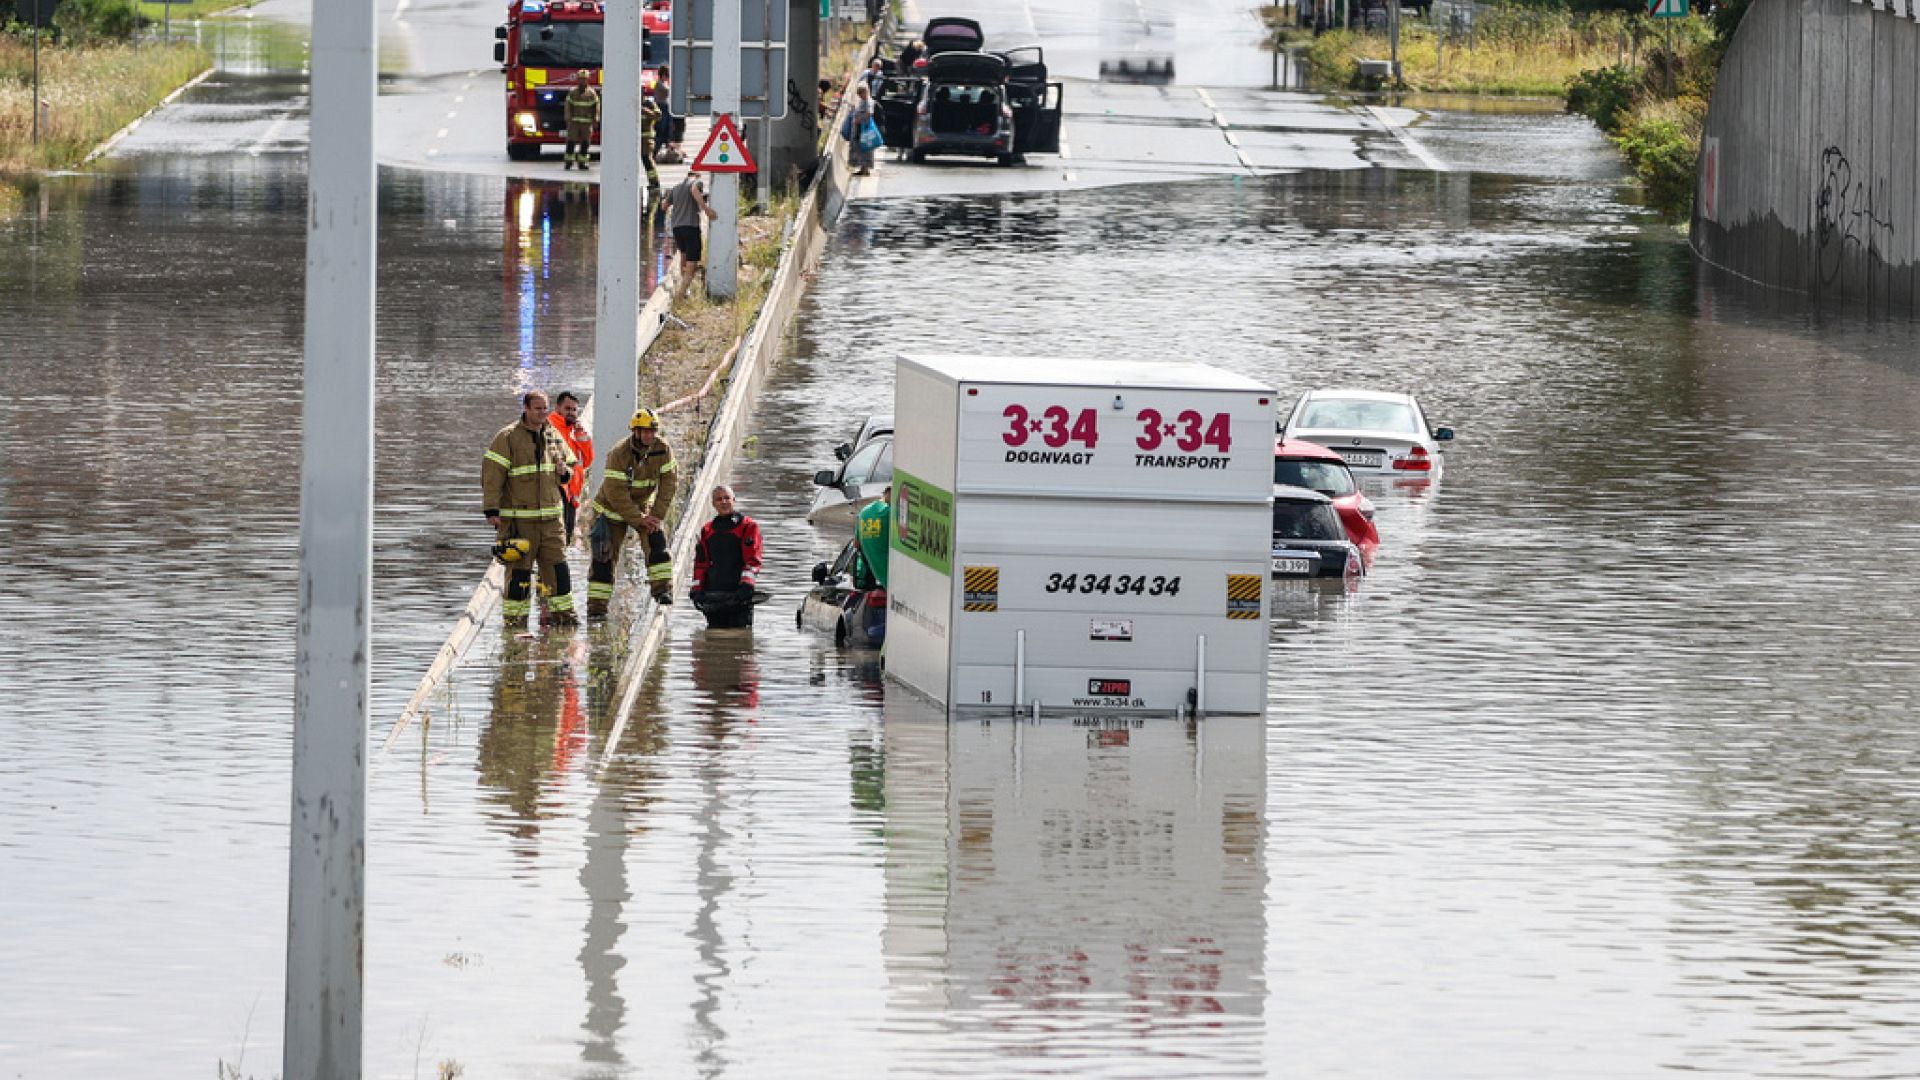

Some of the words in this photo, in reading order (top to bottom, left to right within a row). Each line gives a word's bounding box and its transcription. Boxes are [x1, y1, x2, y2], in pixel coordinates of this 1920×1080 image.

[1005, 451, 1094, 465] DØGNVAGT
[1135, 454, 1231, 470] TRANSPORT
[1071, 697, 1146, 708] www.3x34.dk
